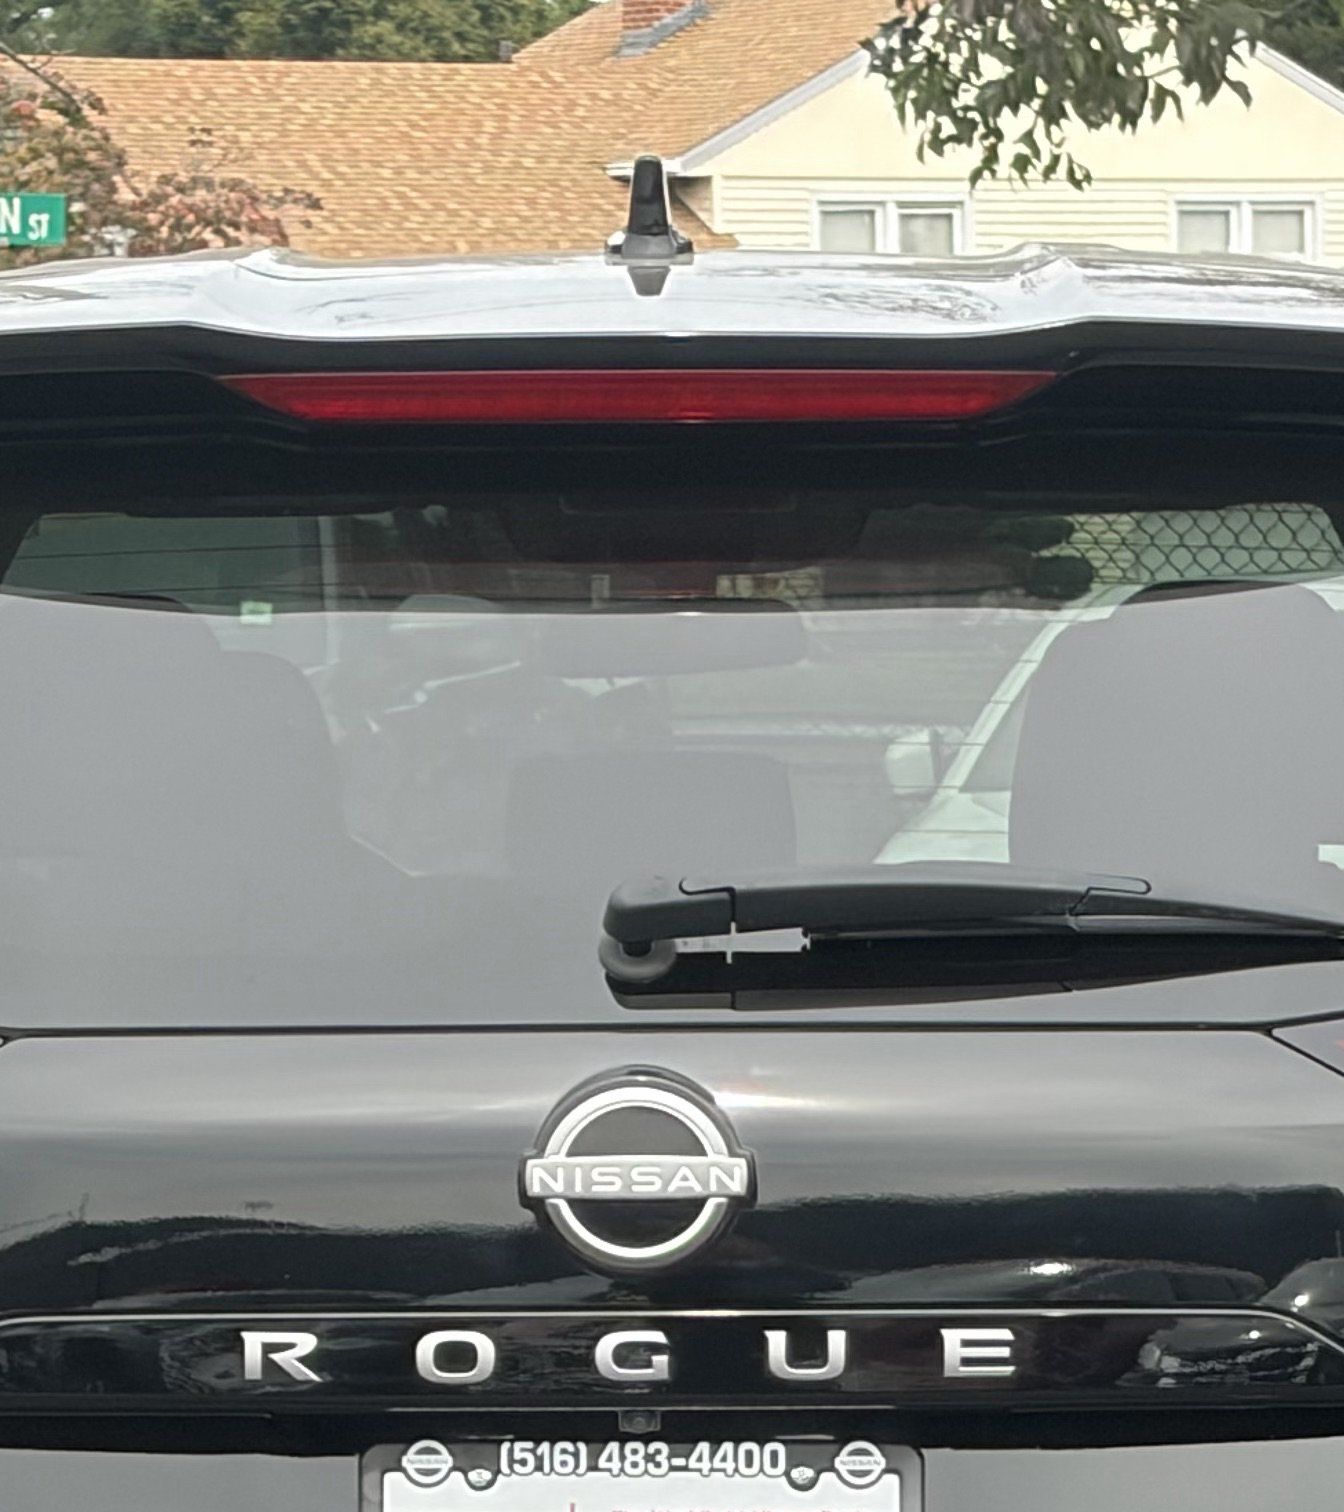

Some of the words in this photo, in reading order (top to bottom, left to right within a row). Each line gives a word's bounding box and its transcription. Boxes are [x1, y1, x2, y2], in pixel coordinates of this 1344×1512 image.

[27, 213, 50, 240] ST
[531, 1165, 745, 1194] NISSAN
[241, 1328, 1017, 1385] ROGUE
[499, 1441, 587, 1476] (516)
[597, 1441, 787, 1477] 483-4400
